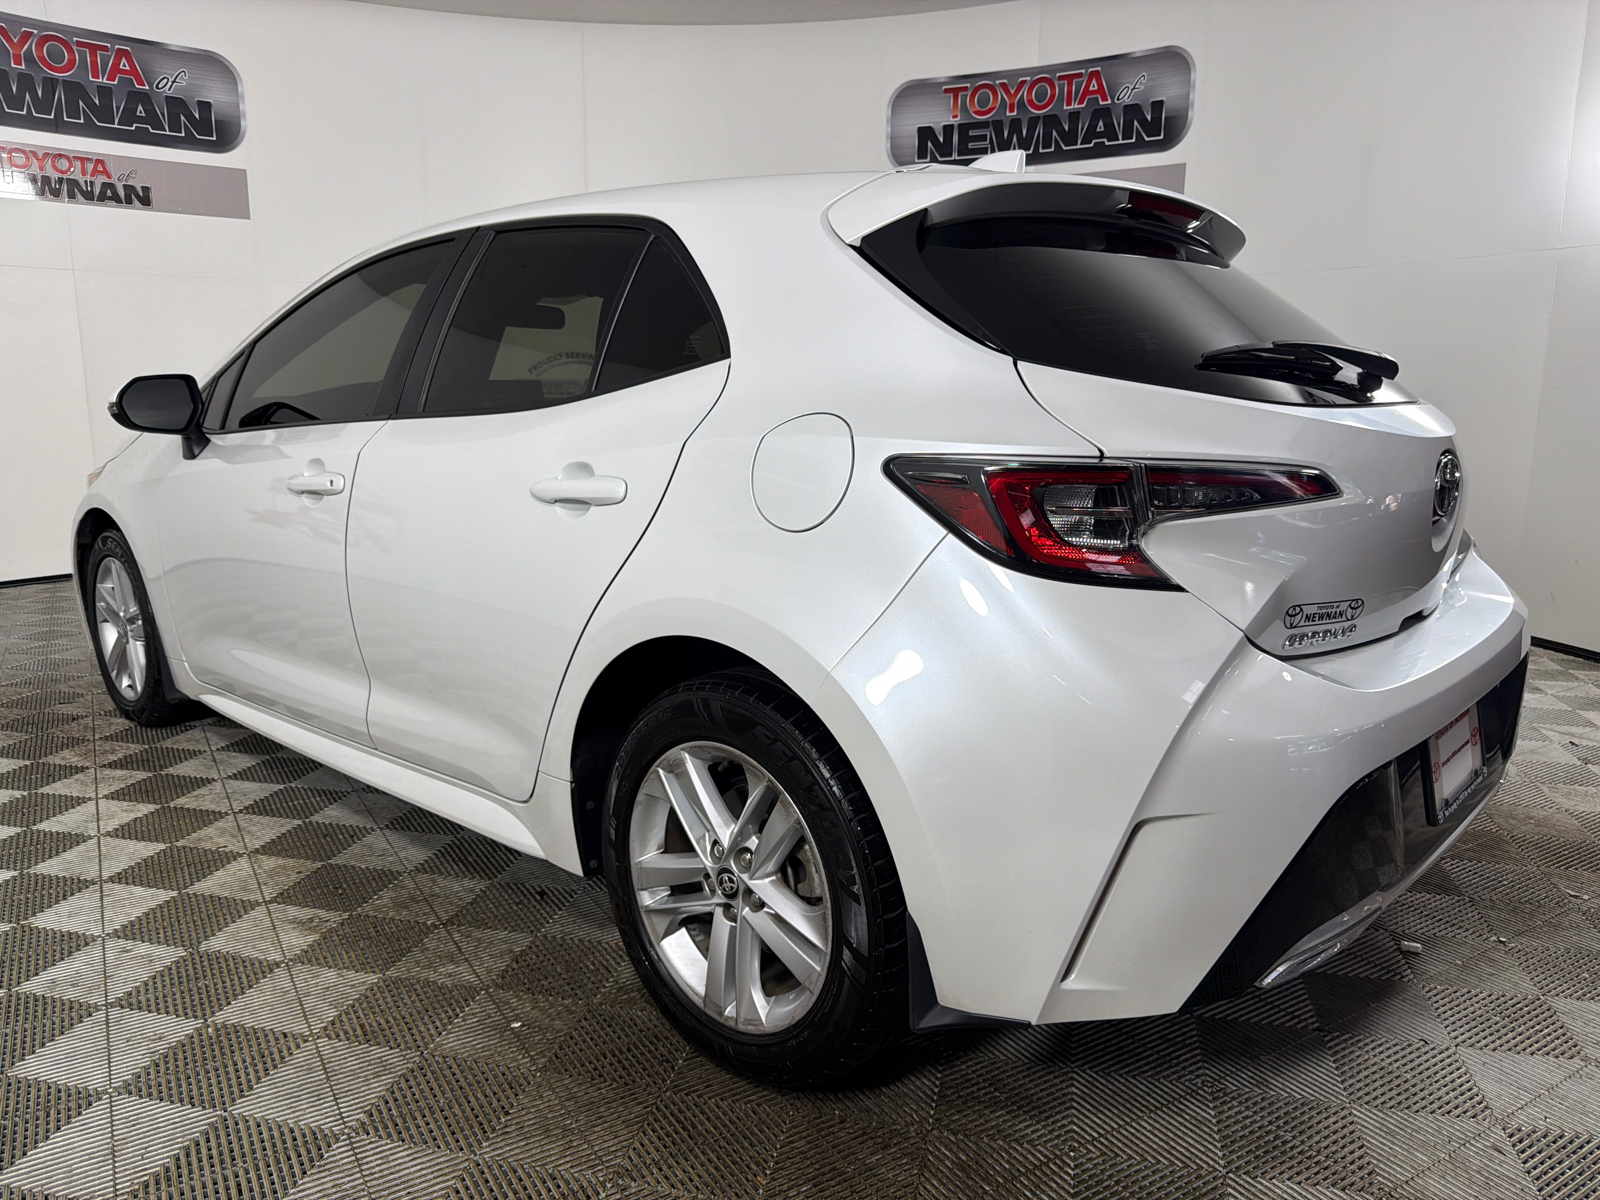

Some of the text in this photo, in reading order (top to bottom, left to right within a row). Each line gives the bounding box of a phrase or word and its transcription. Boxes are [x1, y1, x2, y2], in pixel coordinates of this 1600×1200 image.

[154, 69, 187, 92] of
[942, 67, 1147, 120] TOYOTA of
[915, 98, 1165, 162] NEWNAN
[117, 169, 137, 182] of
[22, 171, 152, 208] WNAN
[527, 353, 563, 375] PROUDLY
[1304, 609, 1345, 623] NEWNAN
[1282, 624, 1357, 650] COROLLA
